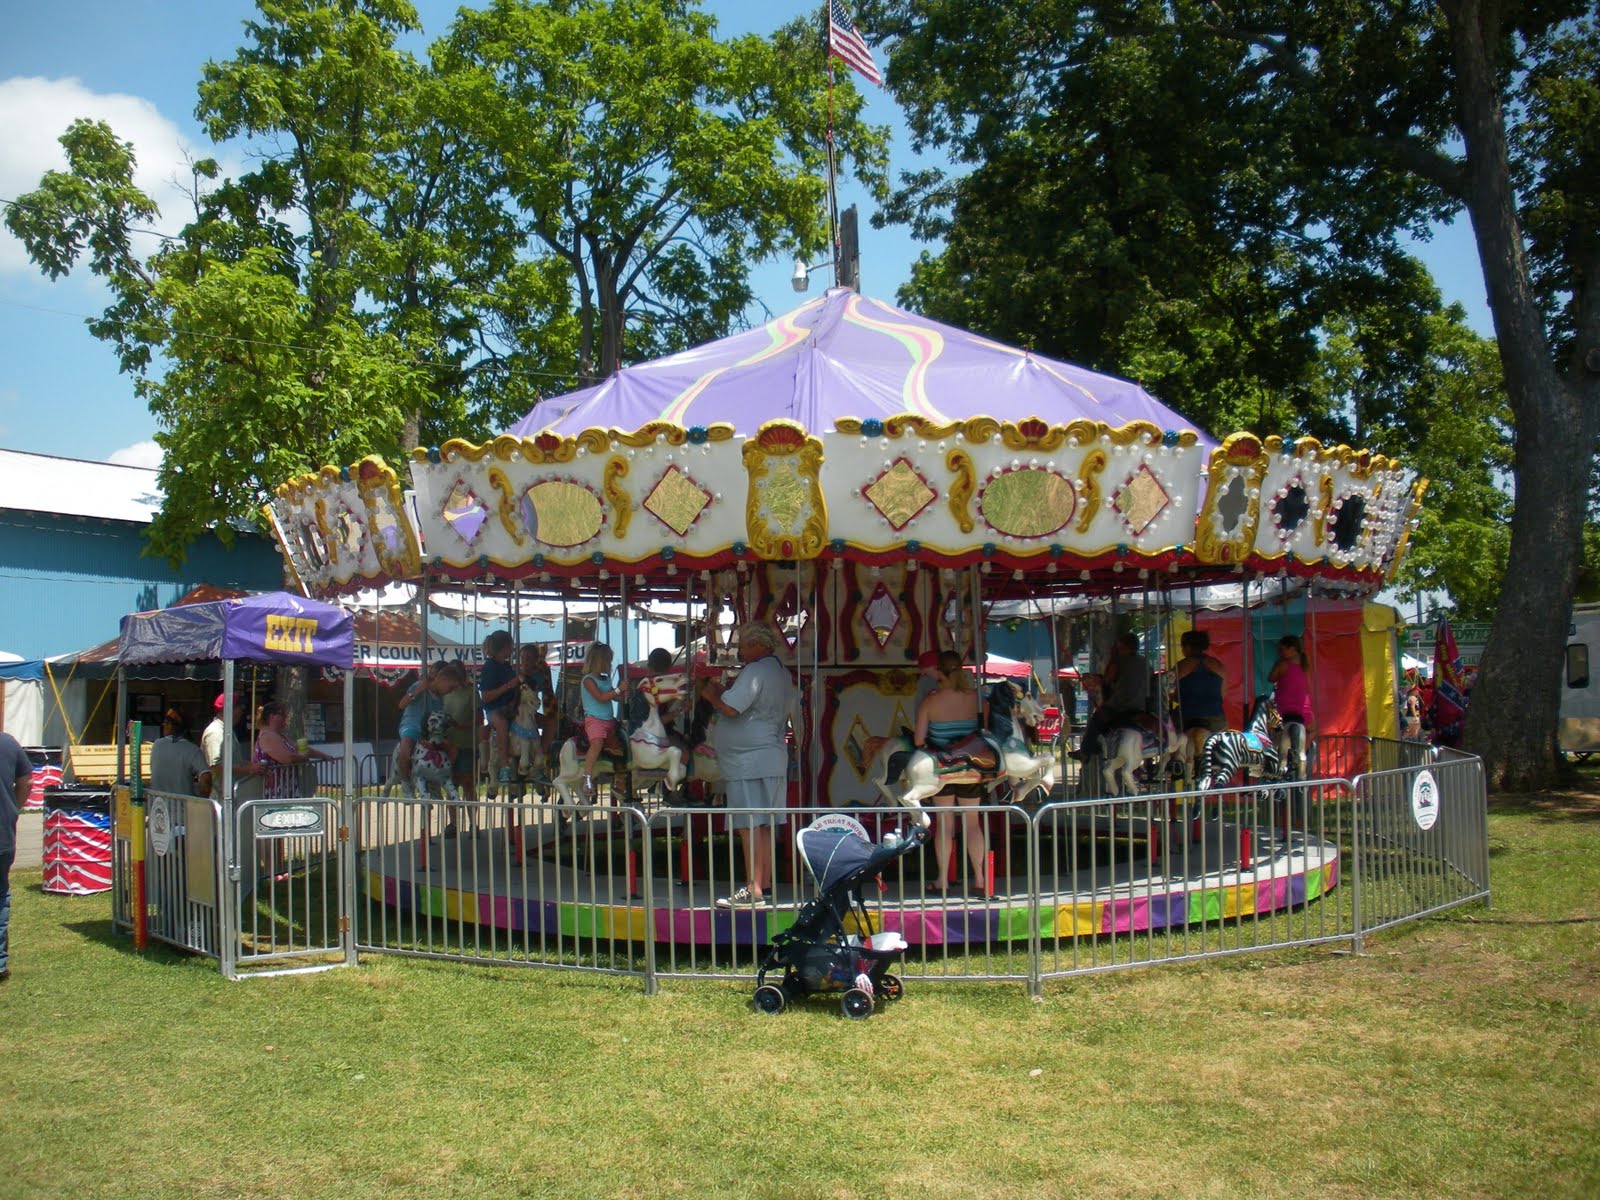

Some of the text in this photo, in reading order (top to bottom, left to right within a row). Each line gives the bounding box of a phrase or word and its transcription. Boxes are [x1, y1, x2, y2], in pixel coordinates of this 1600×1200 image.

[264, 614, 318, 653] EXIT
[352, 644, 371, 659] ER
[379, 646, 448, 661] COUNTY
[274, 812, 305, 825] EXIT
[846, 821, 865, 838] SHOW
